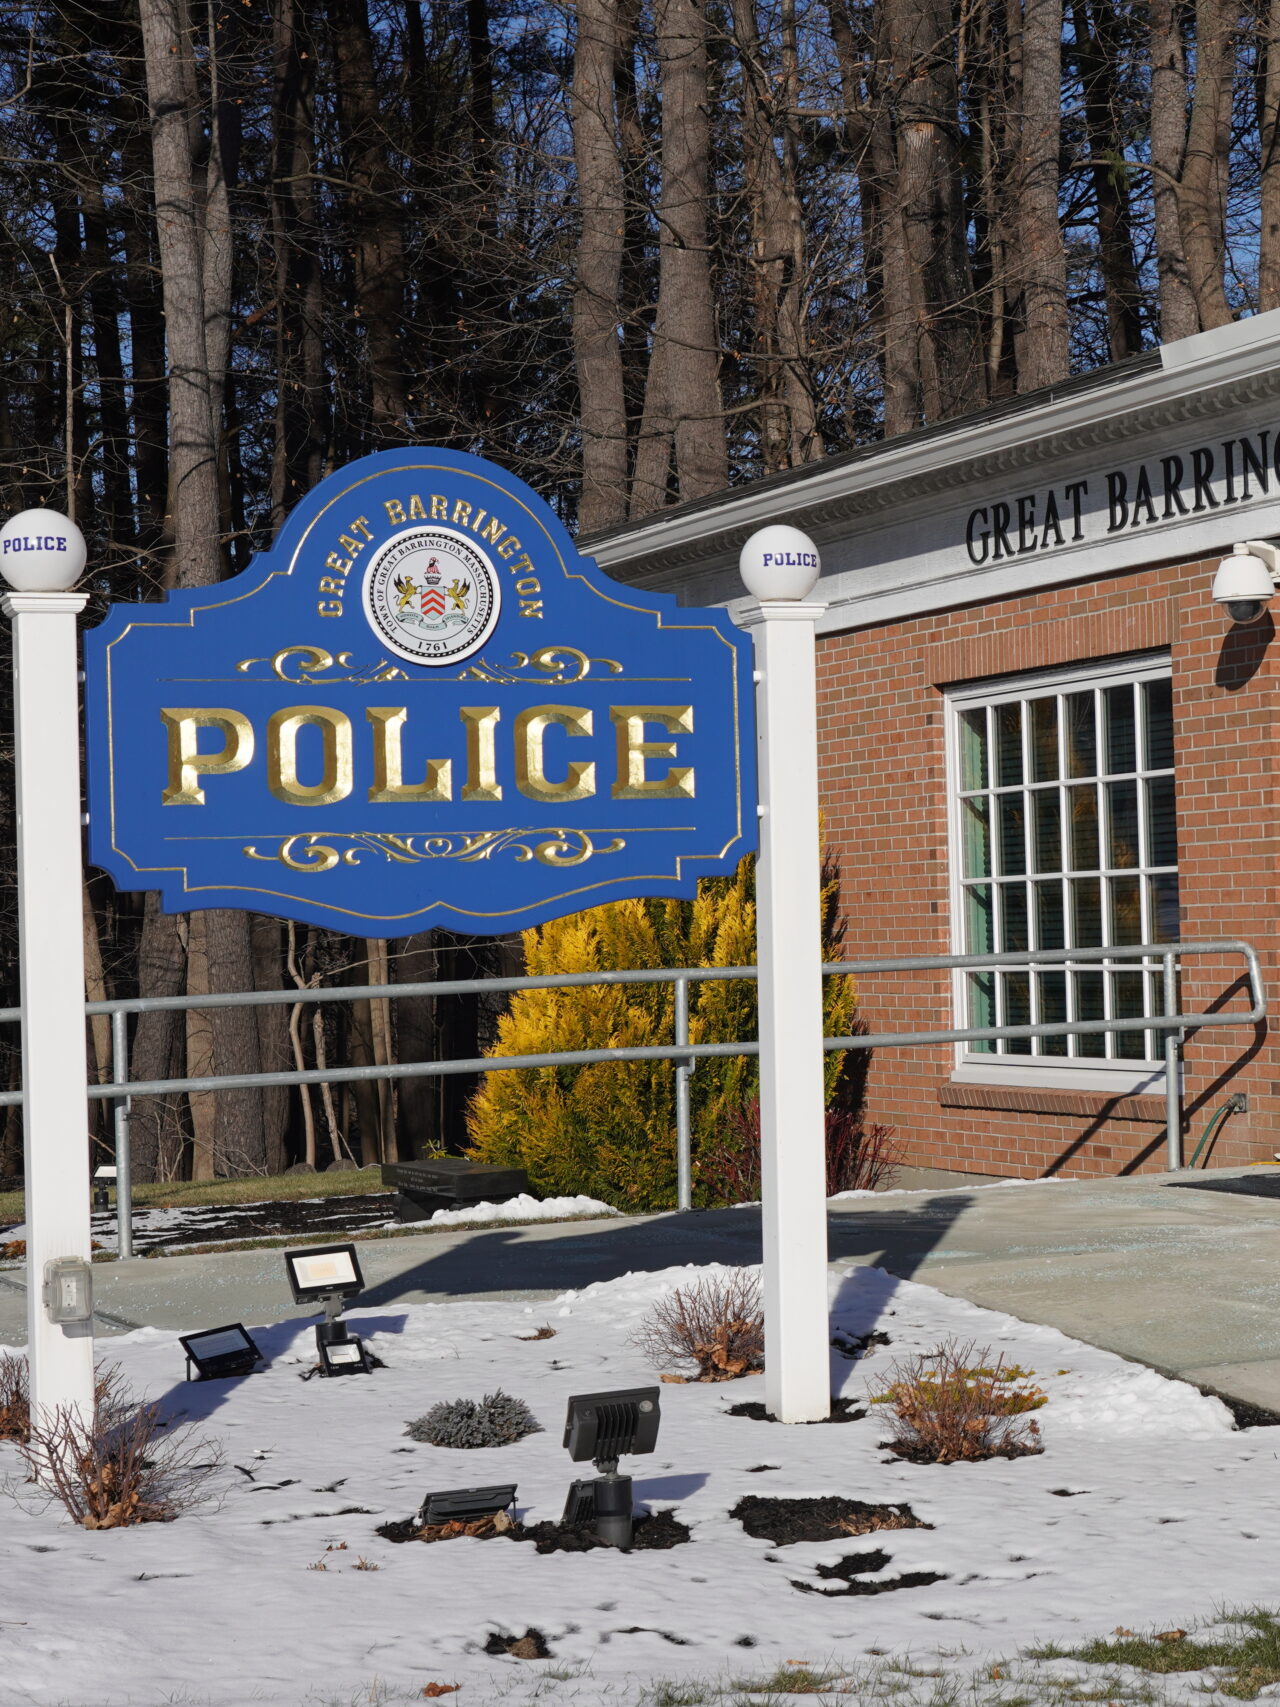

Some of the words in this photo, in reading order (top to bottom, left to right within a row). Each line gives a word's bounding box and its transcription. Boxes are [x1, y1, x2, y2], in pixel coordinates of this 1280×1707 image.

[965, 480, 1089, 566] GREAT
[3, 536, 67, 555] POLICE
[317, 515, 375, 618] GREAT
[383, 494, 544, 620] BARRINGTON
[398, 539, 463, 556] BARRINGTON
[762, 552, 817, 568] POLICE
[380, 554, 398, 588] GREAT
[376, 588, 385, 602] OF
[463, 554, 488, 635] MASSACHUSETTS
[378, 604, 397, 634] TOWN
[417, 641, 448, 651] 1761
[160, 704, 697, 807] POLICE
